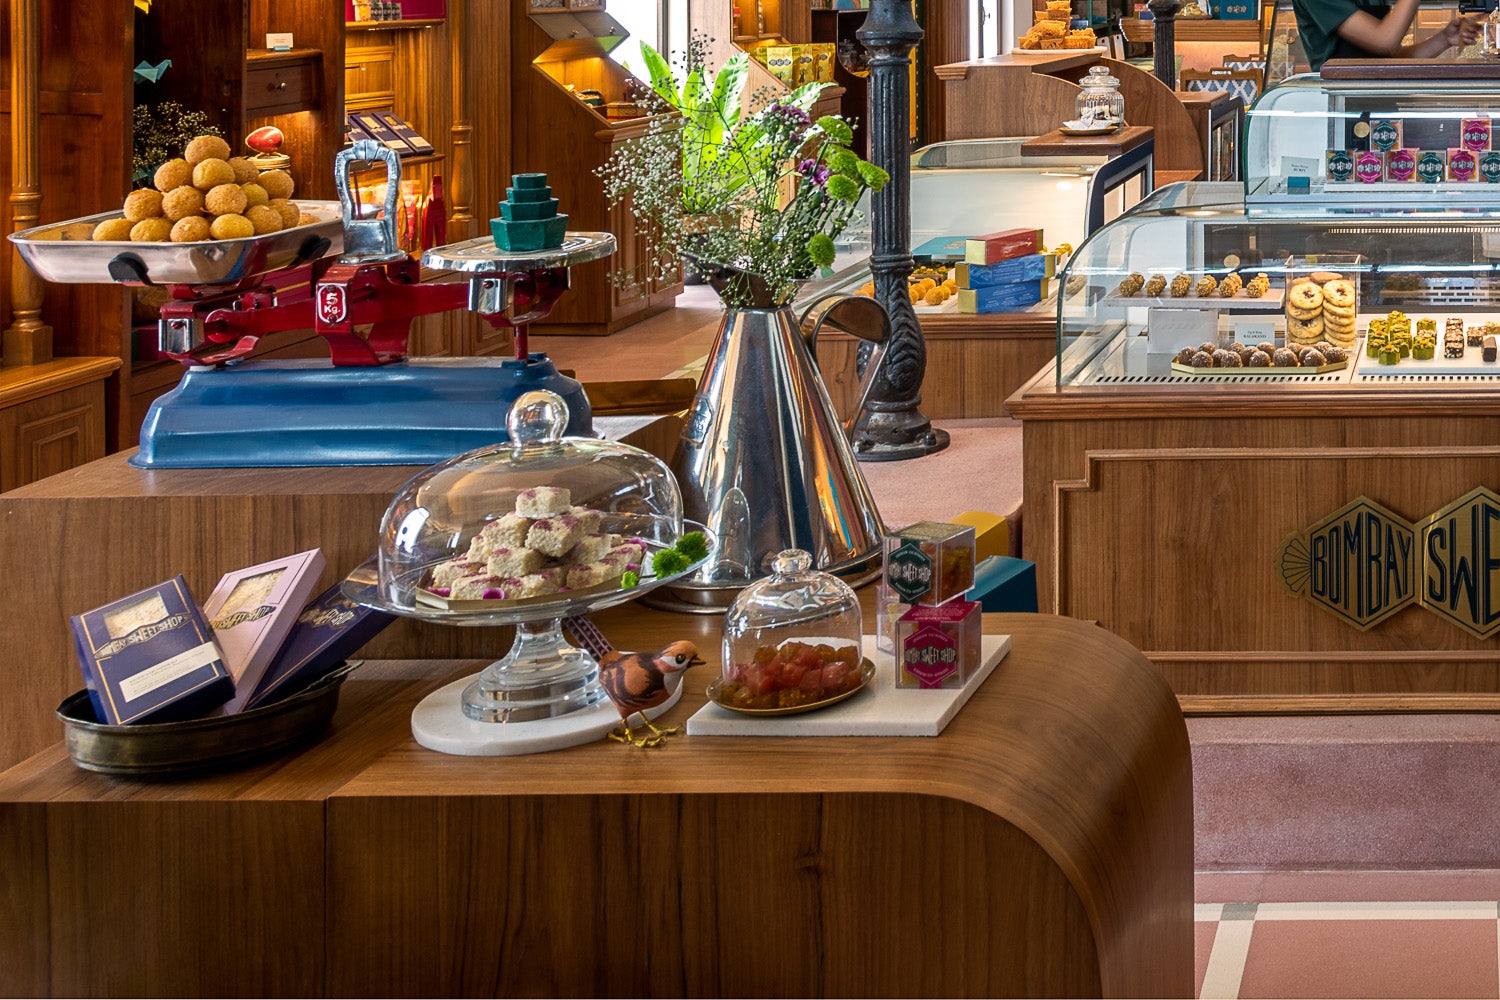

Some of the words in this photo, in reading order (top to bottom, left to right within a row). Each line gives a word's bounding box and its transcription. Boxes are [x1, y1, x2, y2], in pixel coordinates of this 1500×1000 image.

[326, 292, 338, 305] 5
[1312, 511, 1412, 618] BOMBAY
[128, 626, 157, 645] SWEET
[158, 615, 183, 632] SHOP
[940, 647, 956, 664] SHOP
